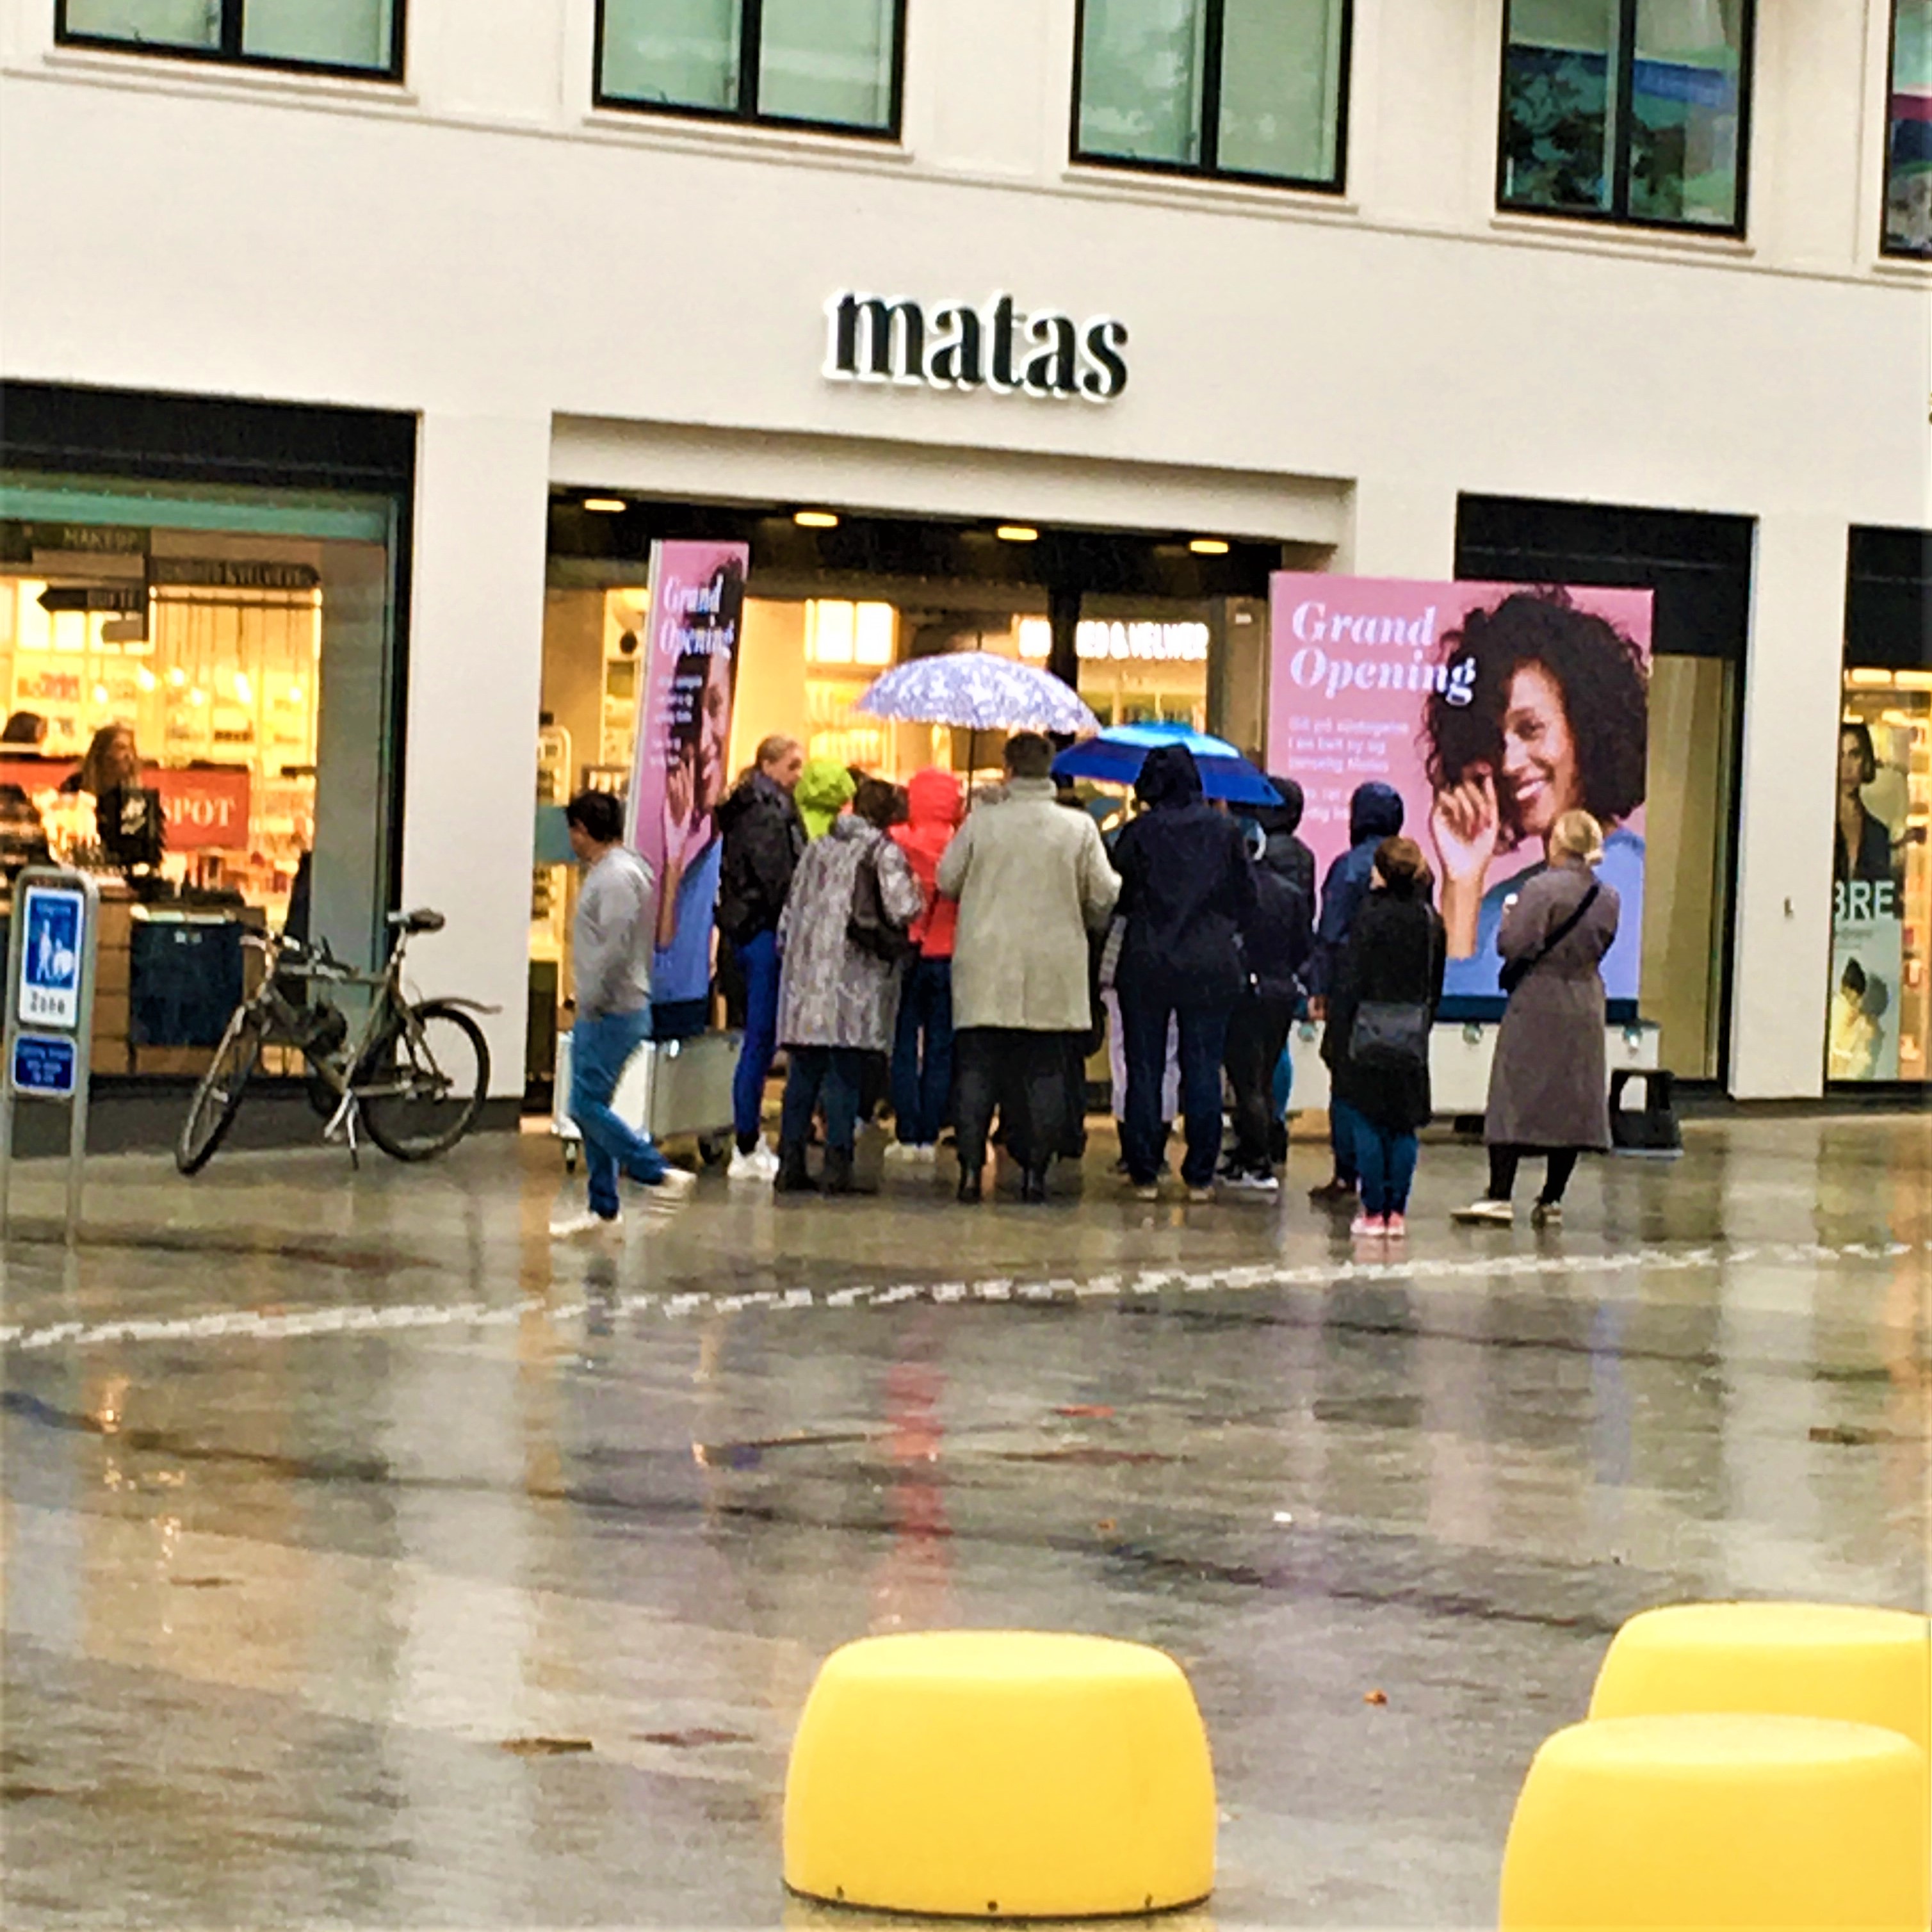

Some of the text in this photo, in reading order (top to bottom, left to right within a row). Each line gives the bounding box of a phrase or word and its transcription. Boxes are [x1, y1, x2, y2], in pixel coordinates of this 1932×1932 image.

[825, 289, 1128, 402] matas
[1292, 601, 1436, 645] Grand
[1290, 646, 1476, 705] Opening
